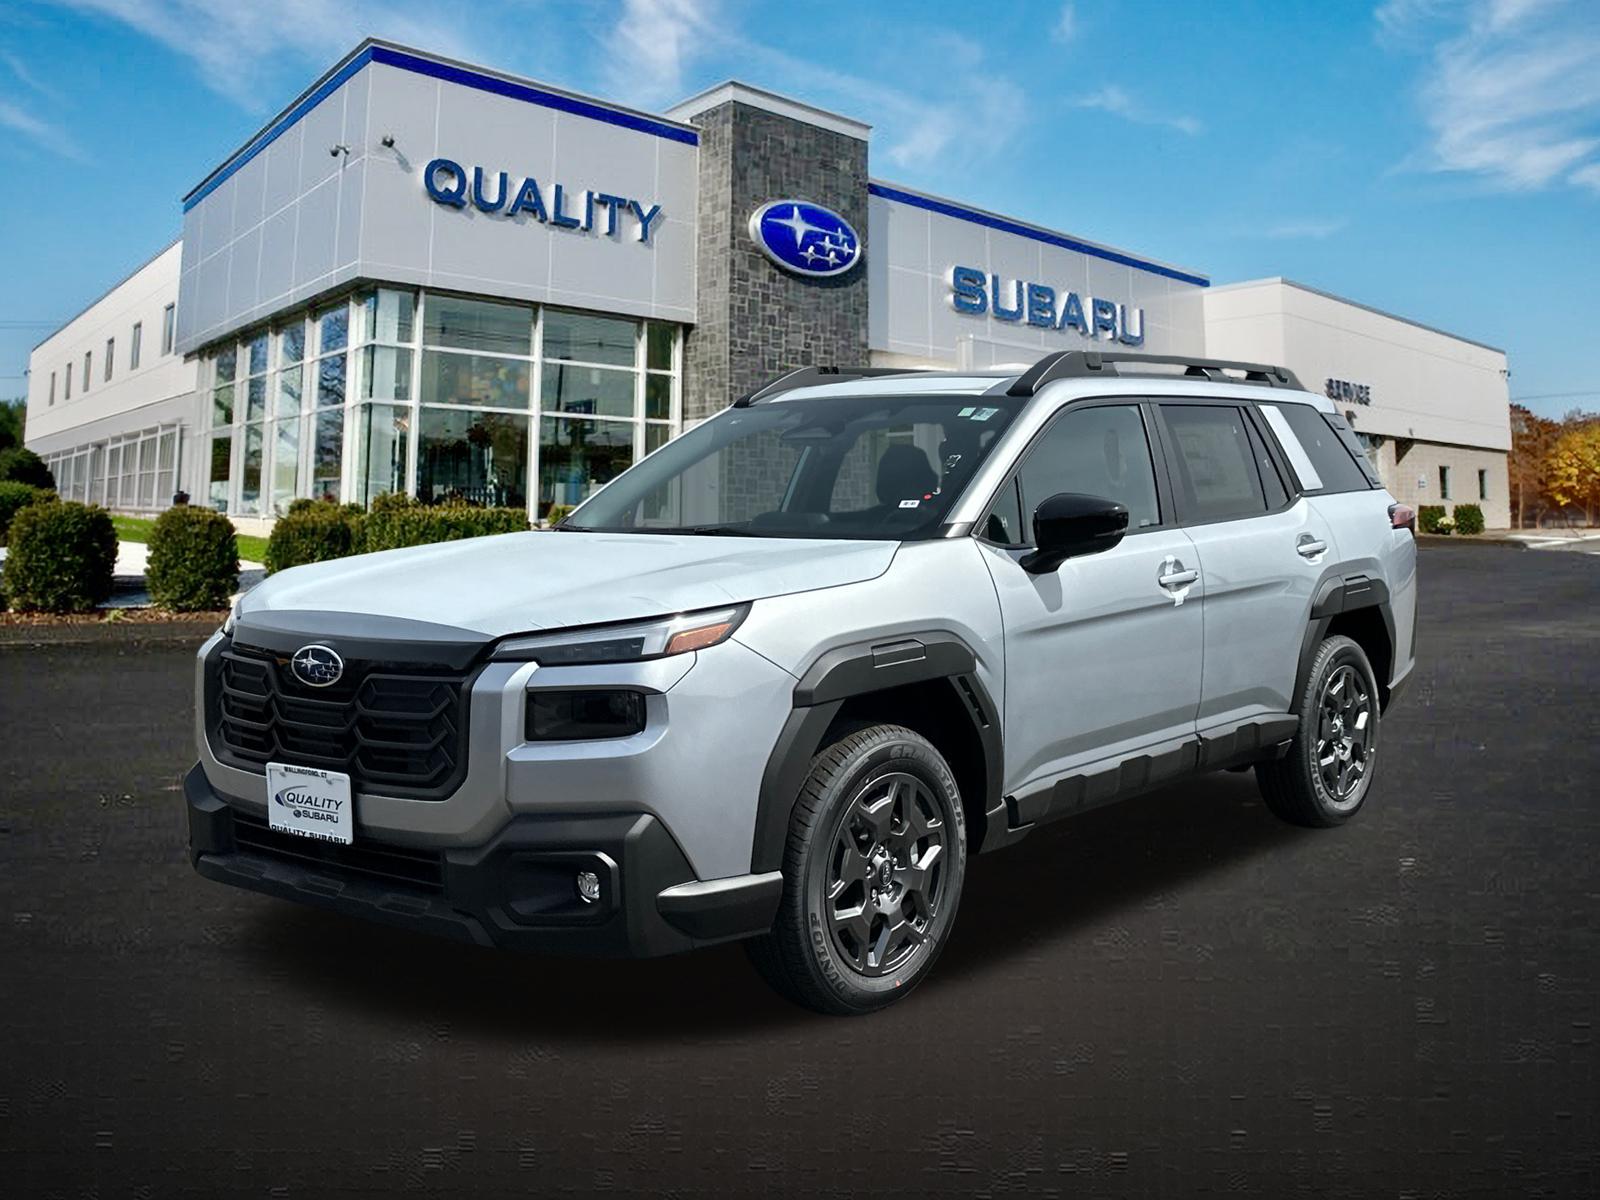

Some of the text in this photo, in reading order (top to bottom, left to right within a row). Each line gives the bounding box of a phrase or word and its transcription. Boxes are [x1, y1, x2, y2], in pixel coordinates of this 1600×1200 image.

[424, 158, 661, 243] QUALITY
[947, 265, 1145, 346] SUBARU
[286, 792, 343, 810] QUALITY
[302, 810, 339, 823] SUBARU
[271, 824, 347, 844] QUALITY SUBARU
[810, 912, 847, 993] DUNLOP
